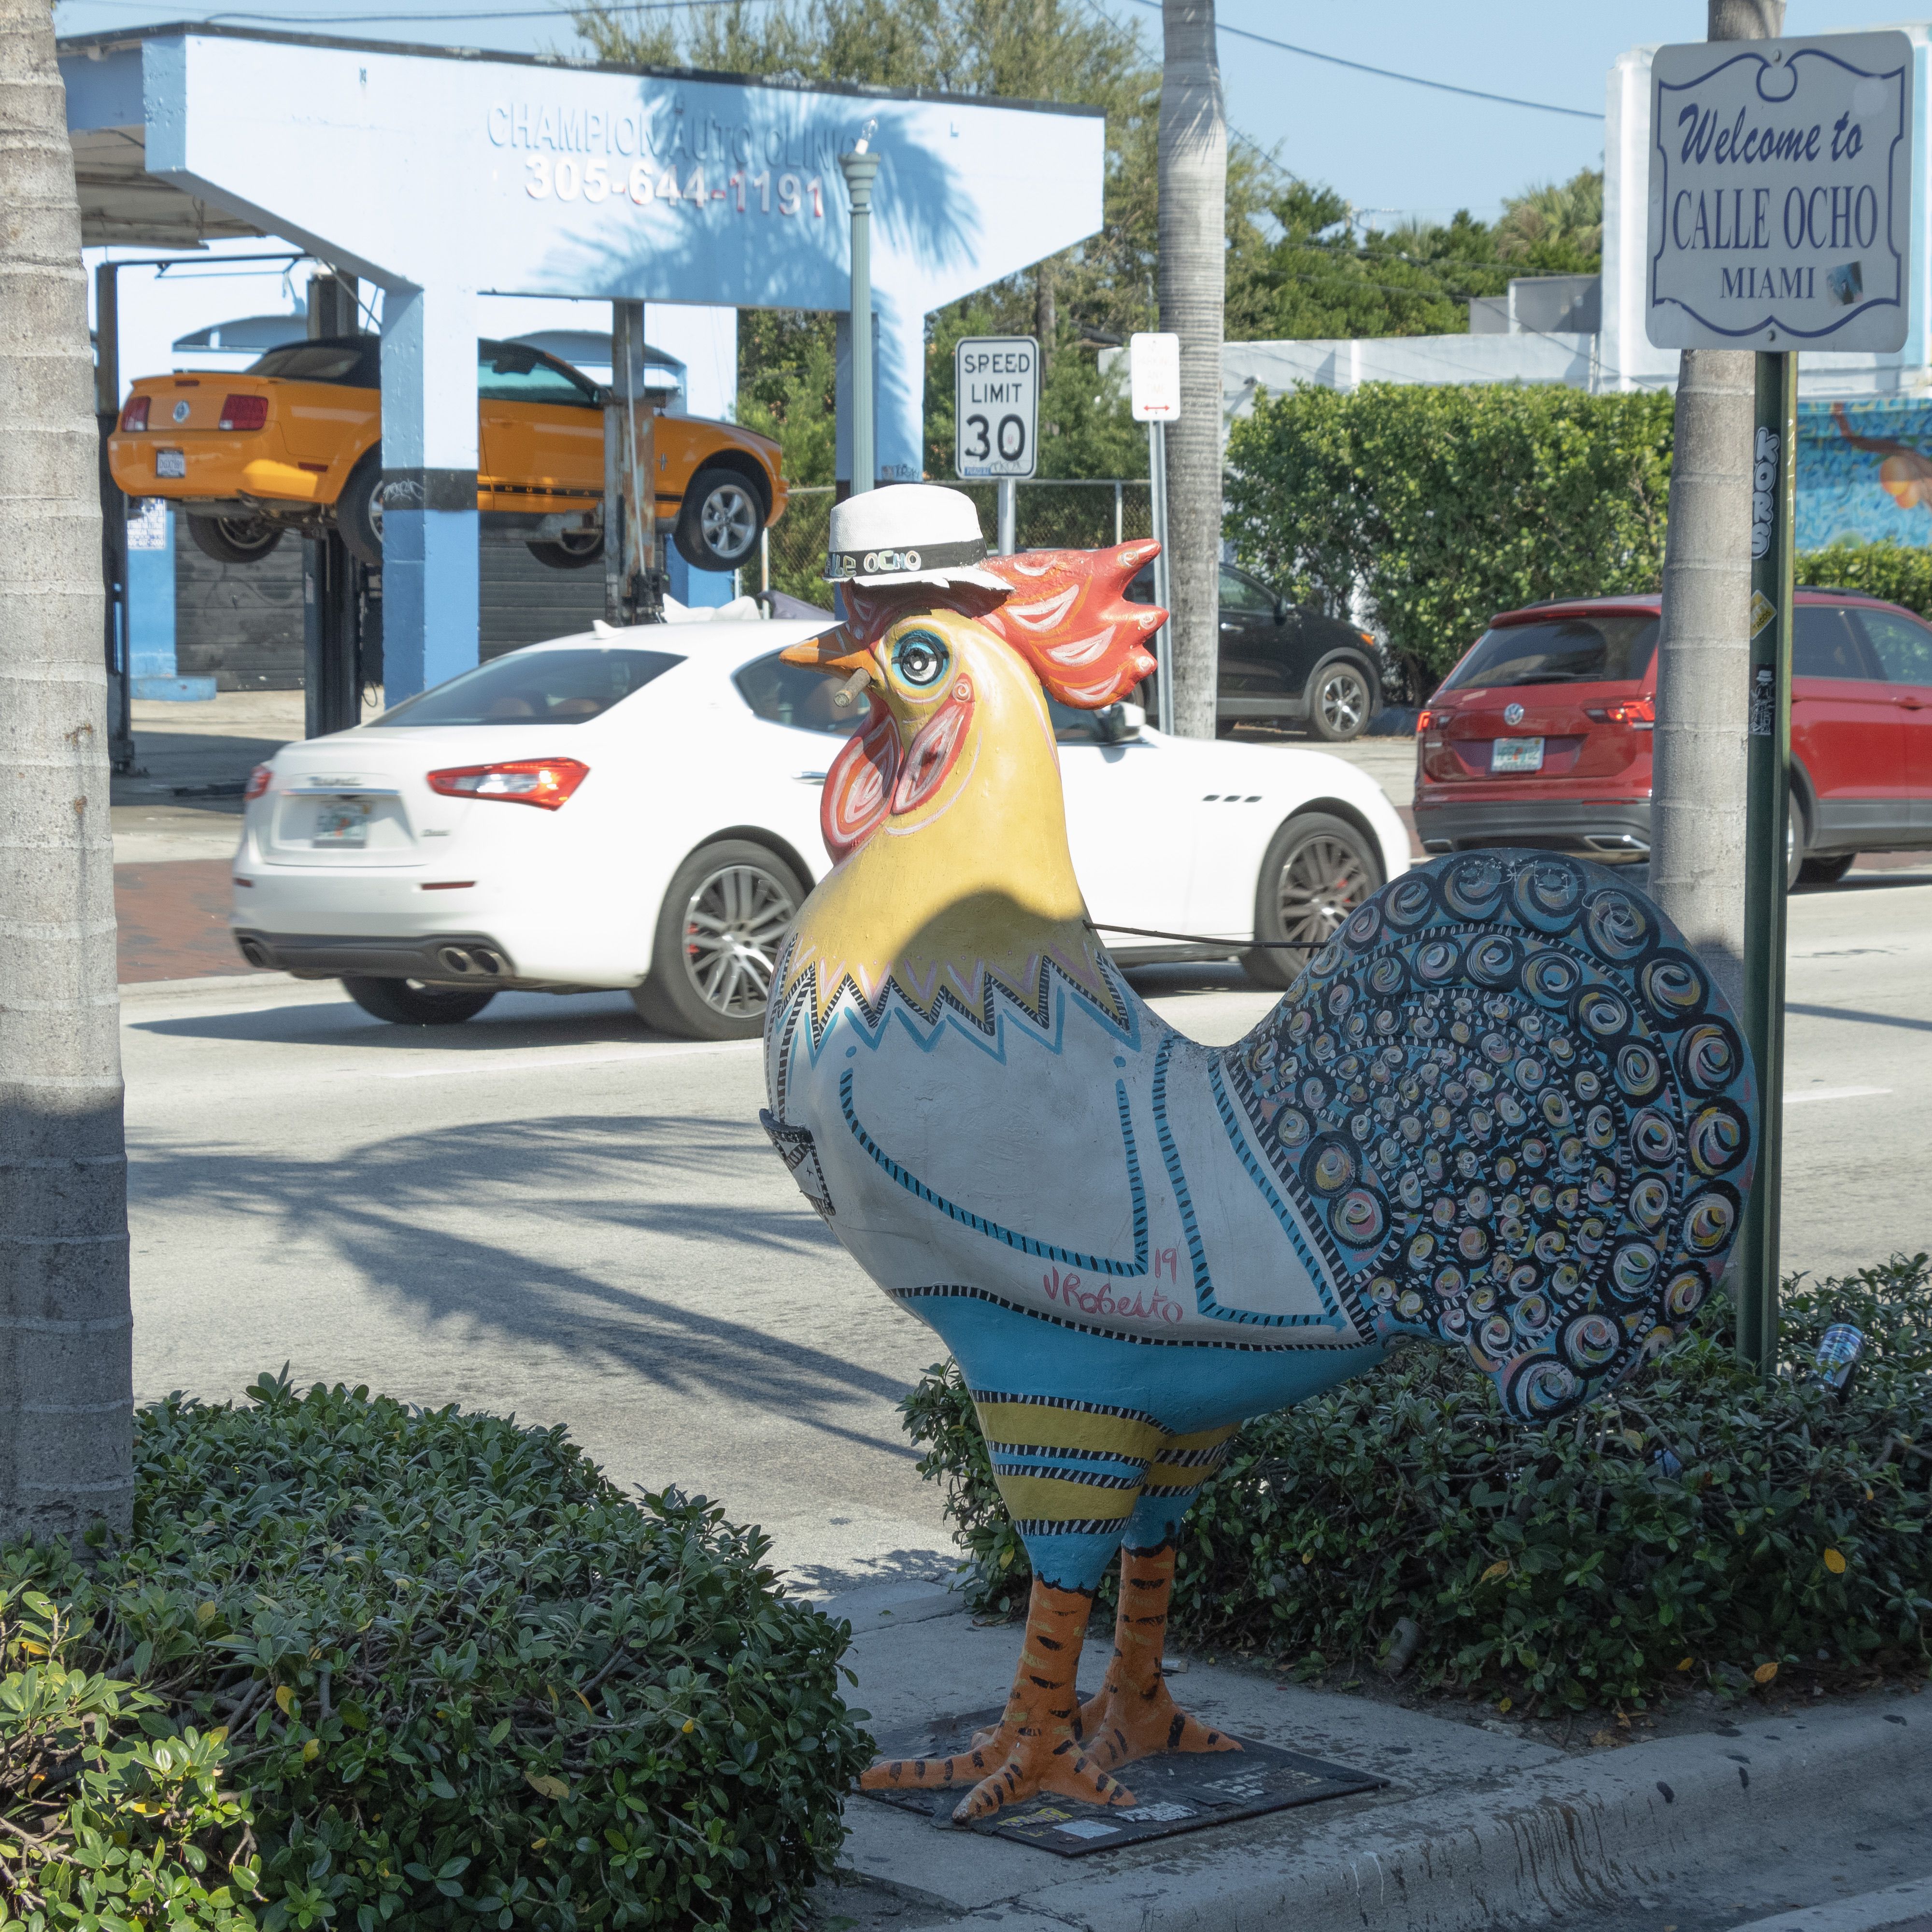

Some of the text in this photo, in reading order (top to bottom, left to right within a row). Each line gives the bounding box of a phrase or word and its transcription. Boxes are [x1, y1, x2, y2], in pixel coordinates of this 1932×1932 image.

[487, 103, 660, 157] CHAMPION
[668, 115, 752, 165] AUTO
[1678, 103, 1863, 165] Welcome to
[525, 154, 823, 217] 305-644-1191
[1673, 184, 1878, 250] CALLE OCHO
[1719, 266, 1816, 299] MIAMI
[965, 353, 1030, 373] SPEED
[971, 383, 1023, 403] LIMIT
[965, 413, 1025, 461] 30
[864, 550, 922, 573] OCHO
